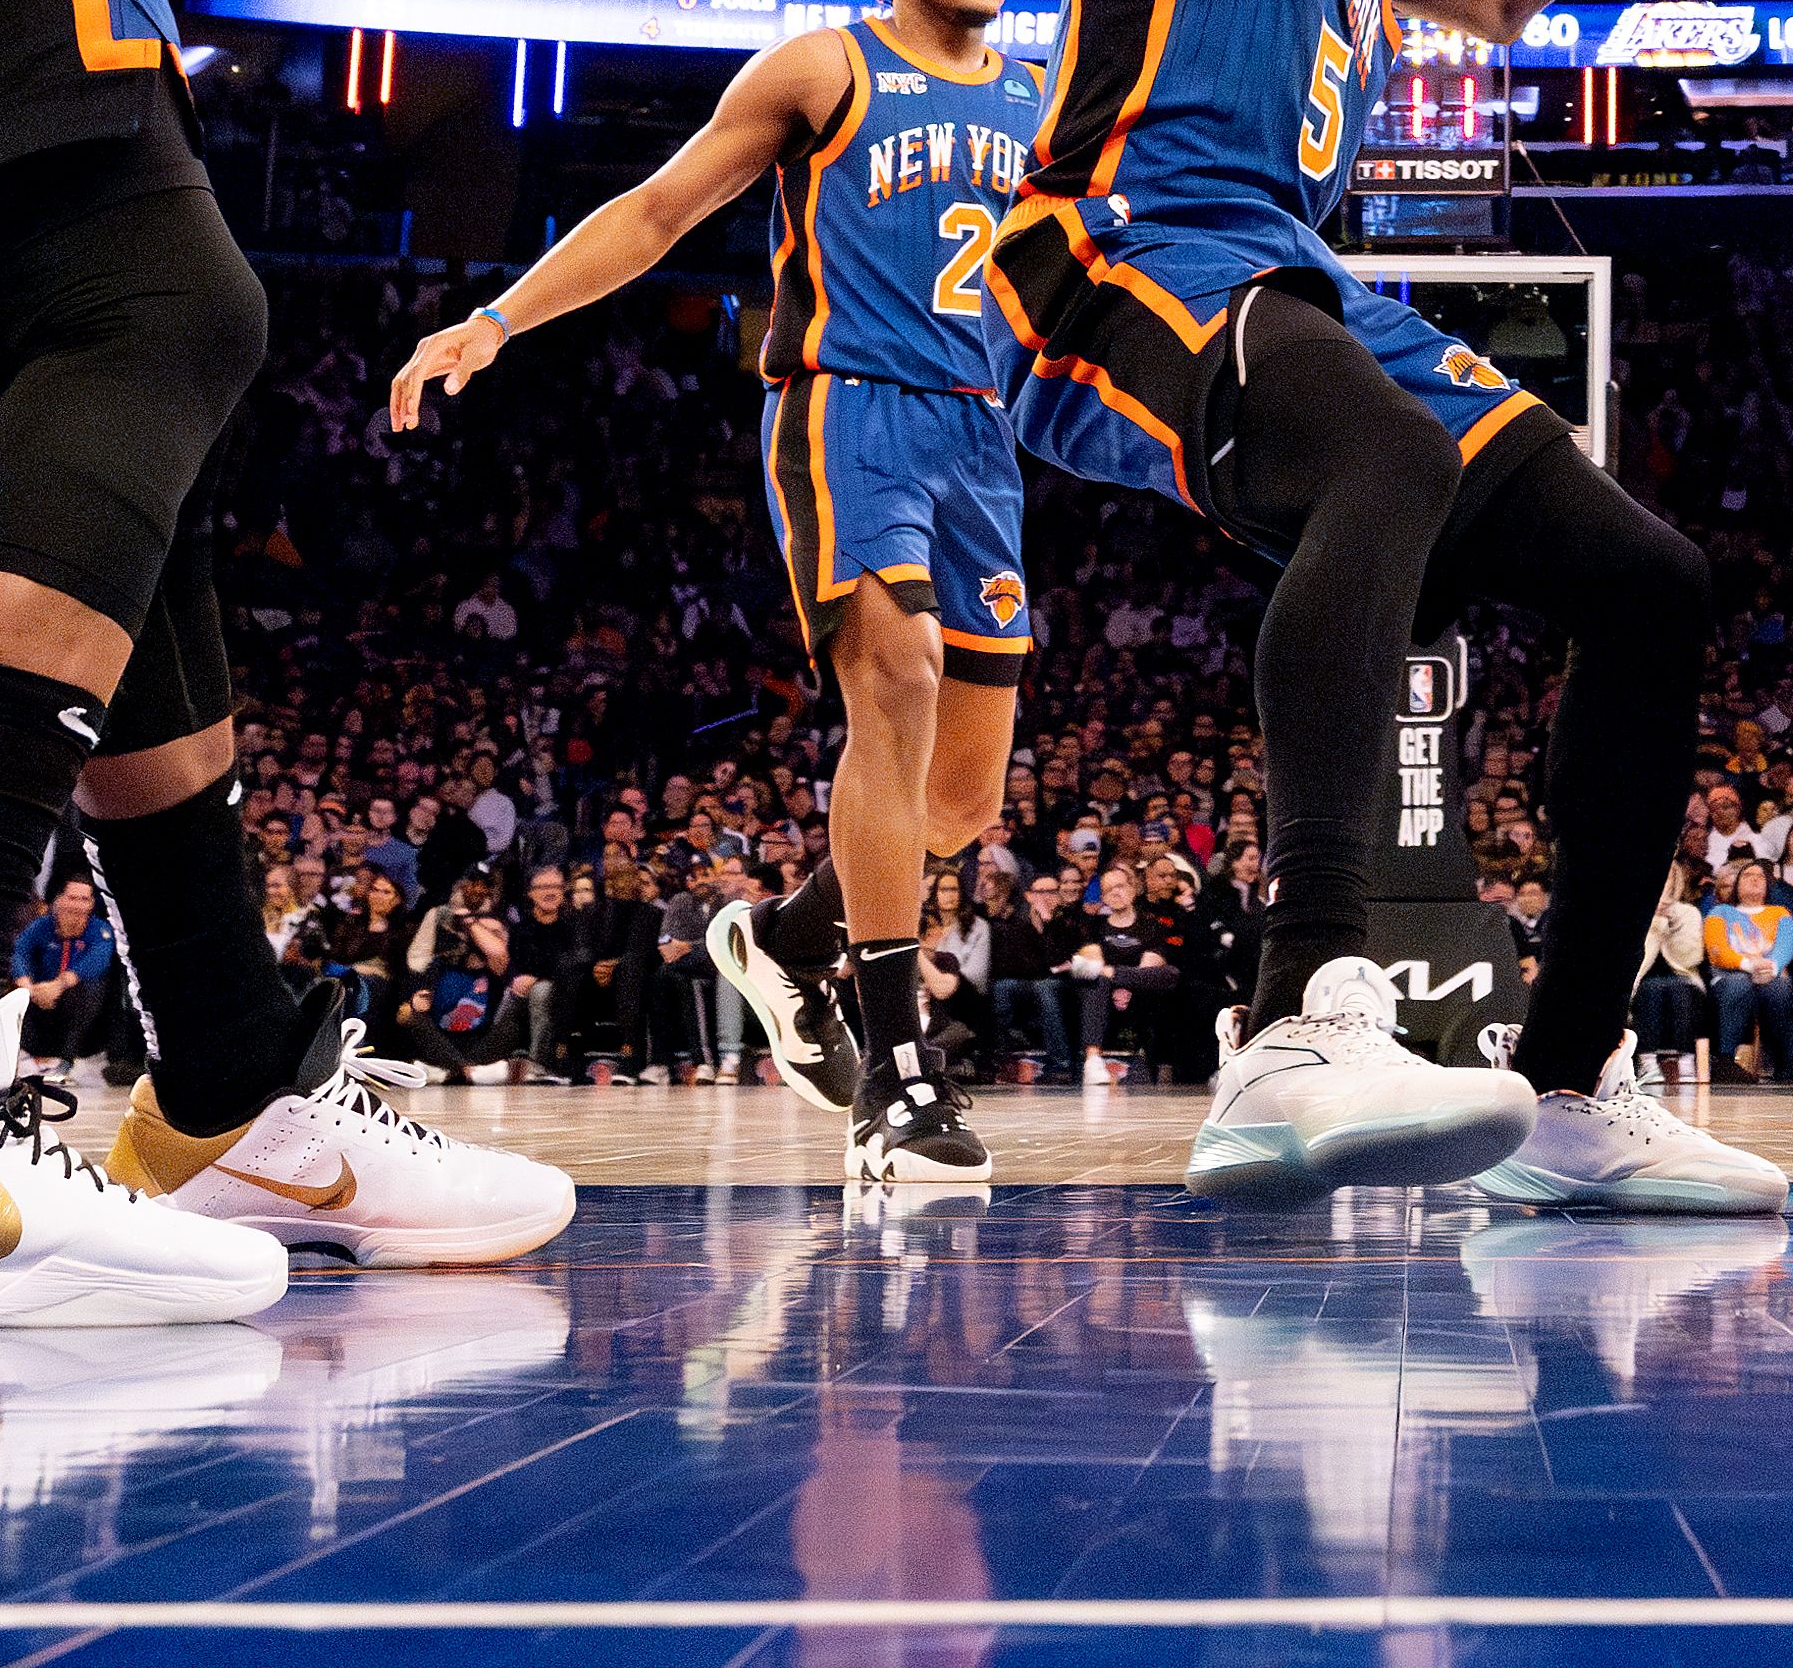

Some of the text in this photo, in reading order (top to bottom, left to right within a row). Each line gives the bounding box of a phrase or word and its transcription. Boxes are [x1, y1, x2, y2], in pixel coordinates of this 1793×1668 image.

[1597, 4, 1761, 65] LAKERS
[875, 71, 928, 95] NYC
[1297, 19, 1354, 182] 5
[867, 121, 956, 209] NEW
[1395, 159, 1501, 180] TISSOT
[932, 201, 998, 318] 2
[1398, 726, 1444, 766] GET
[1398, 767, 1444, 806] THE
[1397, 807, 1445, 848] APP
